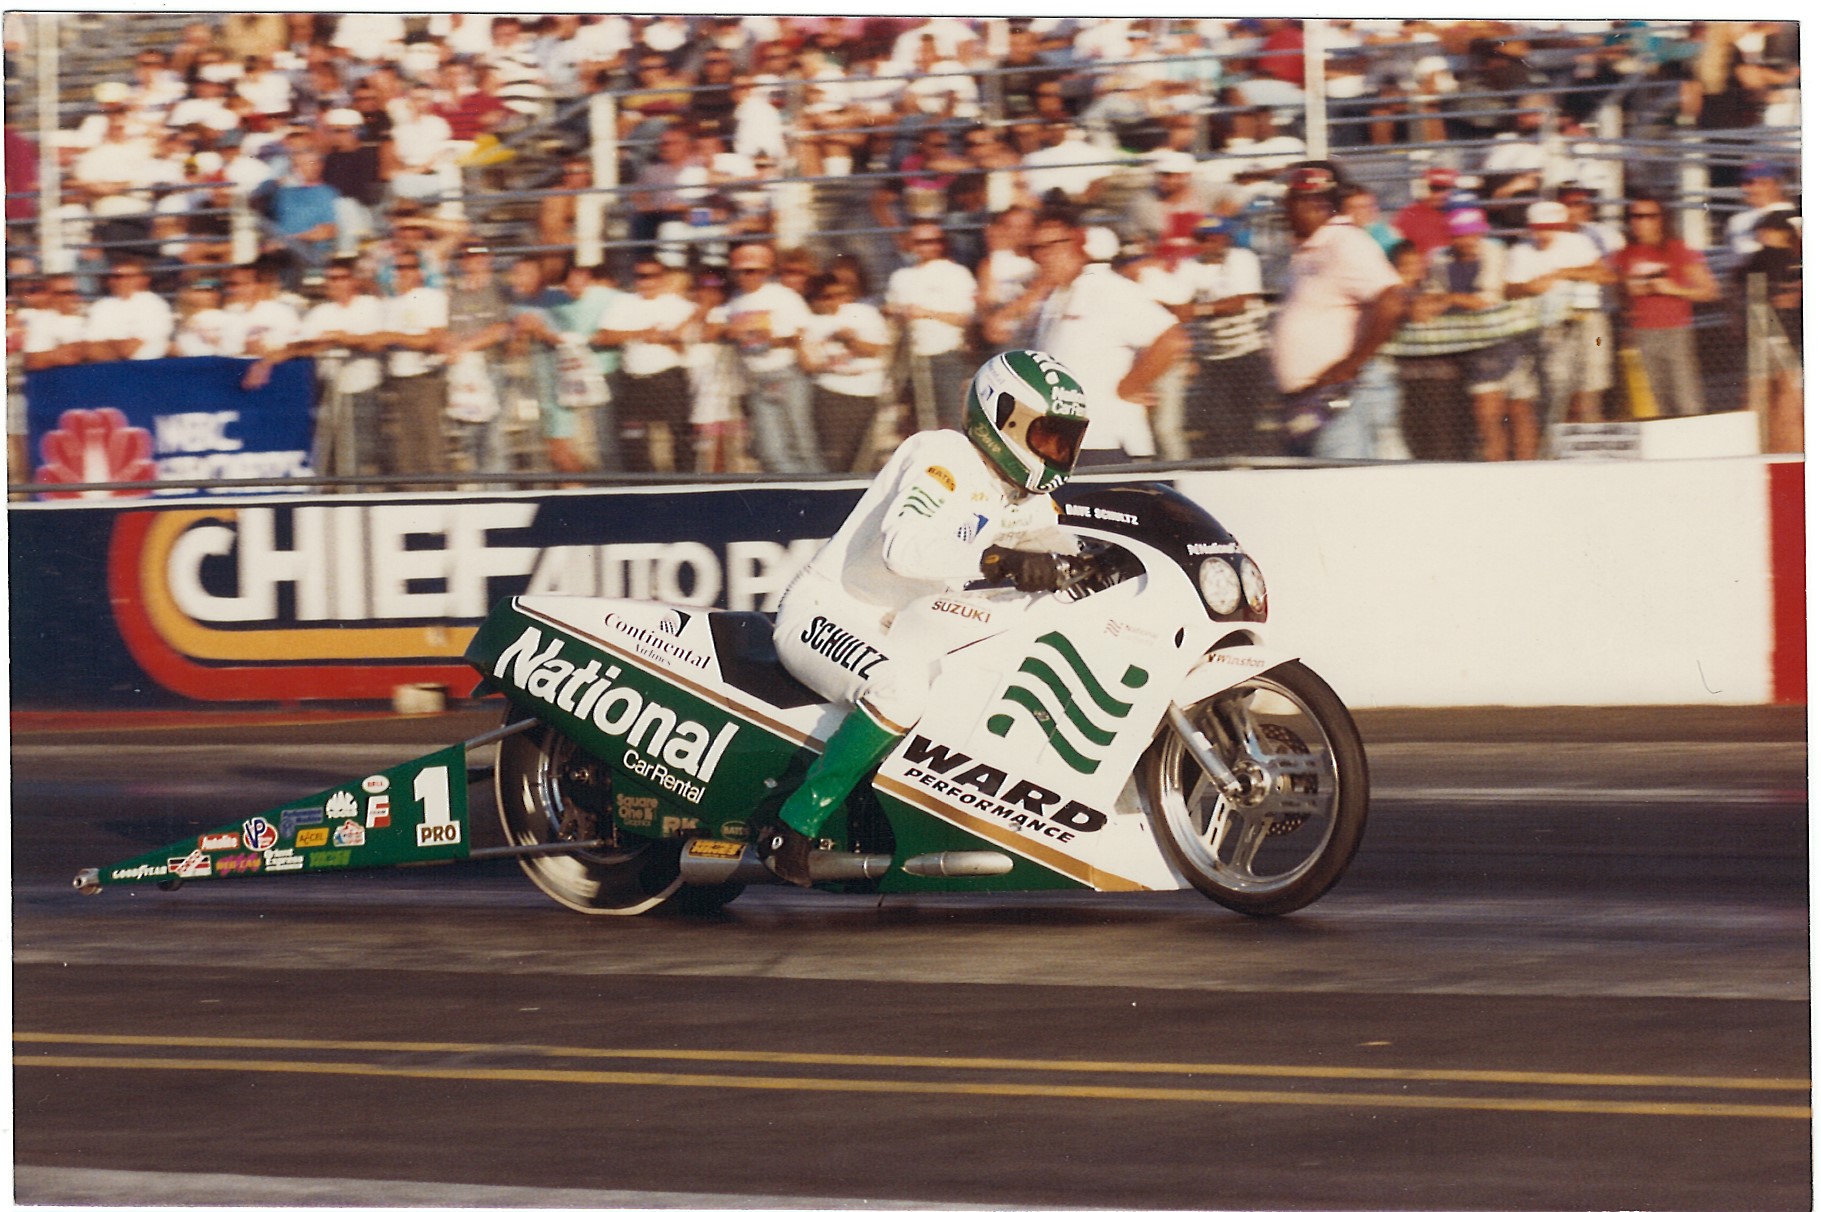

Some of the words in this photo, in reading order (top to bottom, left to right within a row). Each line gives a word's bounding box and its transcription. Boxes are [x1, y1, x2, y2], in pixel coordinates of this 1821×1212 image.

[1065, 503, 1091, 517] DAVE
[1094, 507, 1139, 525] SCHULTZ
[167, 503, 540, 621] CHIEF
[931, 600, 991, 623] SUZUKI
[604, 612, 711, 669] Continental
[800, 615, 890, 681] SCHULTZ
[1217, 653, 1265, 668] Winston
[494, 626, 740, 783] National
[413, 766, 451, 823] 1
[617, 793, 659, 808] Square
[903, 734, 1108, 833] WARD
[904, 767, 1076, 844] PERFORMANCE
[243, 818, 266, 849] VP
[421, 824, 457, 843] PRO
[112, 864, 169, 879] GOODYEAR
